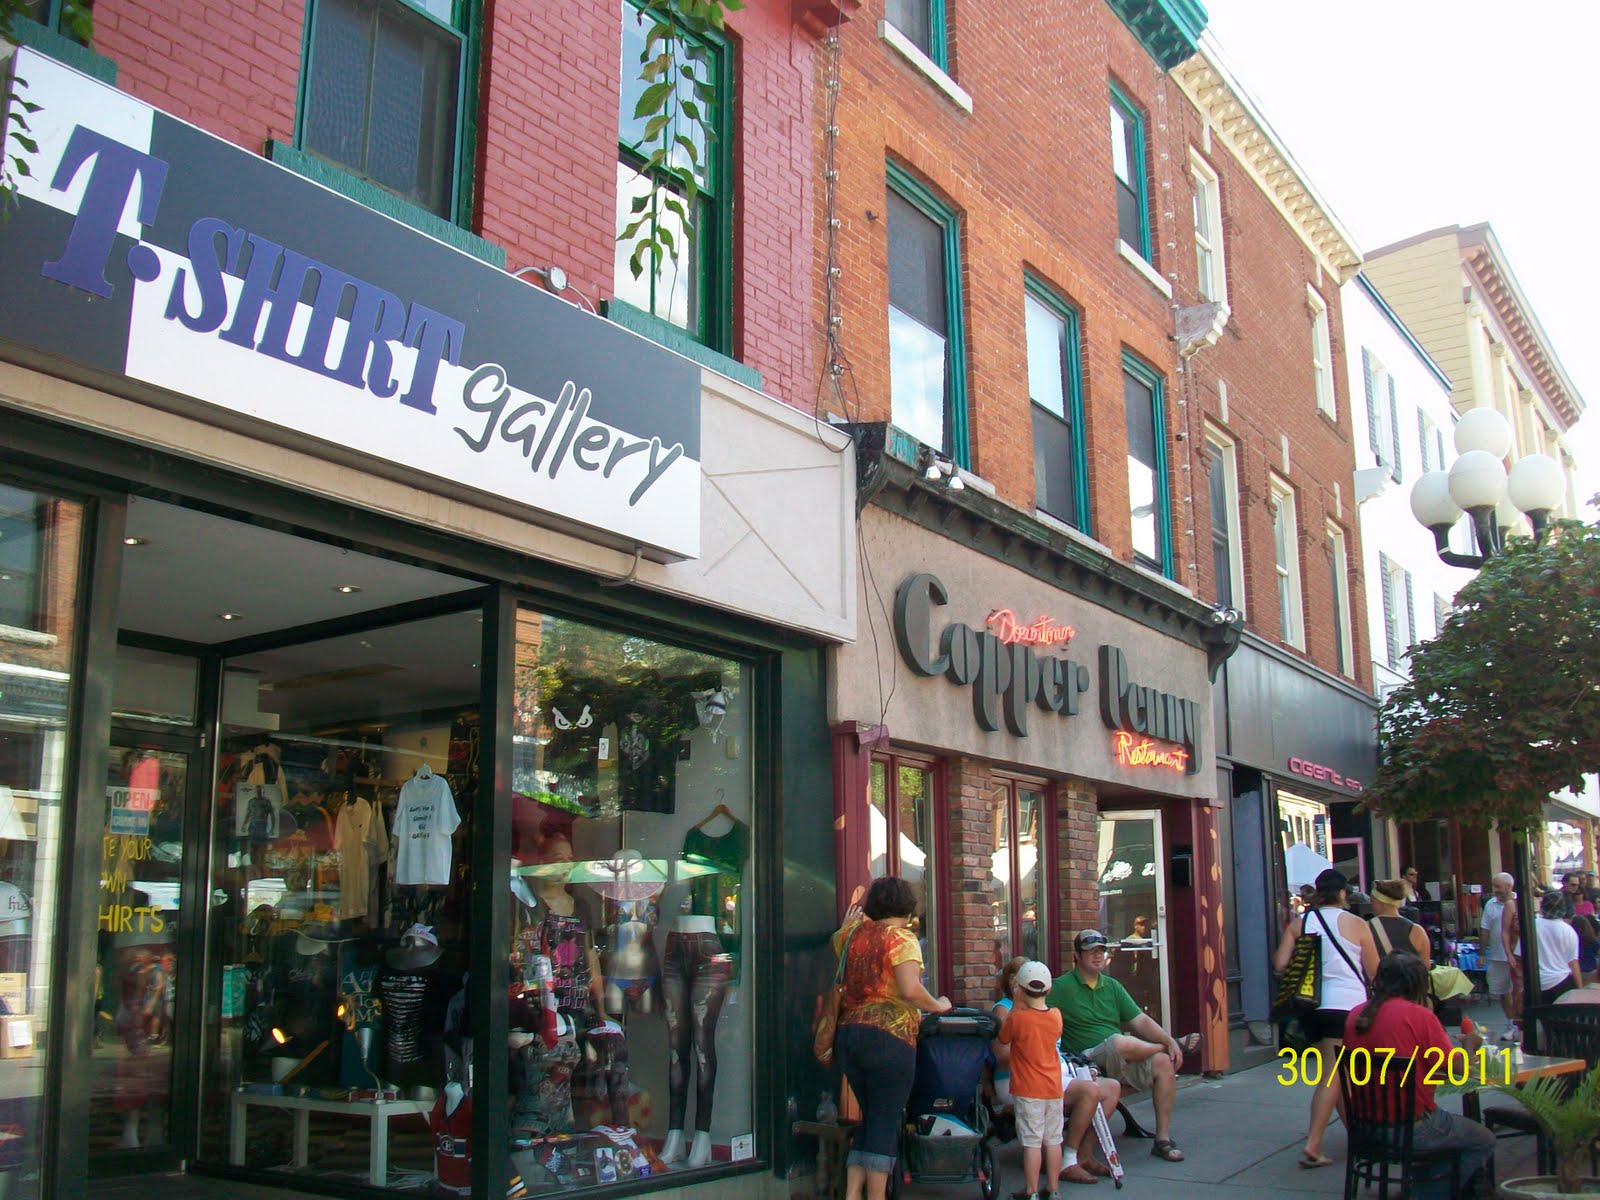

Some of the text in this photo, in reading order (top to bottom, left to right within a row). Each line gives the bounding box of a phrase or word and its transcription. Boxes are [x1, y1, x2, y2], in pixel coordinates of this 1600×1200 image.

[453, 361, 686, 507] gallery
[987, 608, 1076, 645] Downtown
[893, 572, 1202, 775] Copper Penny
[114, 790, 150, 809] OPEN
[121, 838, 152, 862] YOUR
